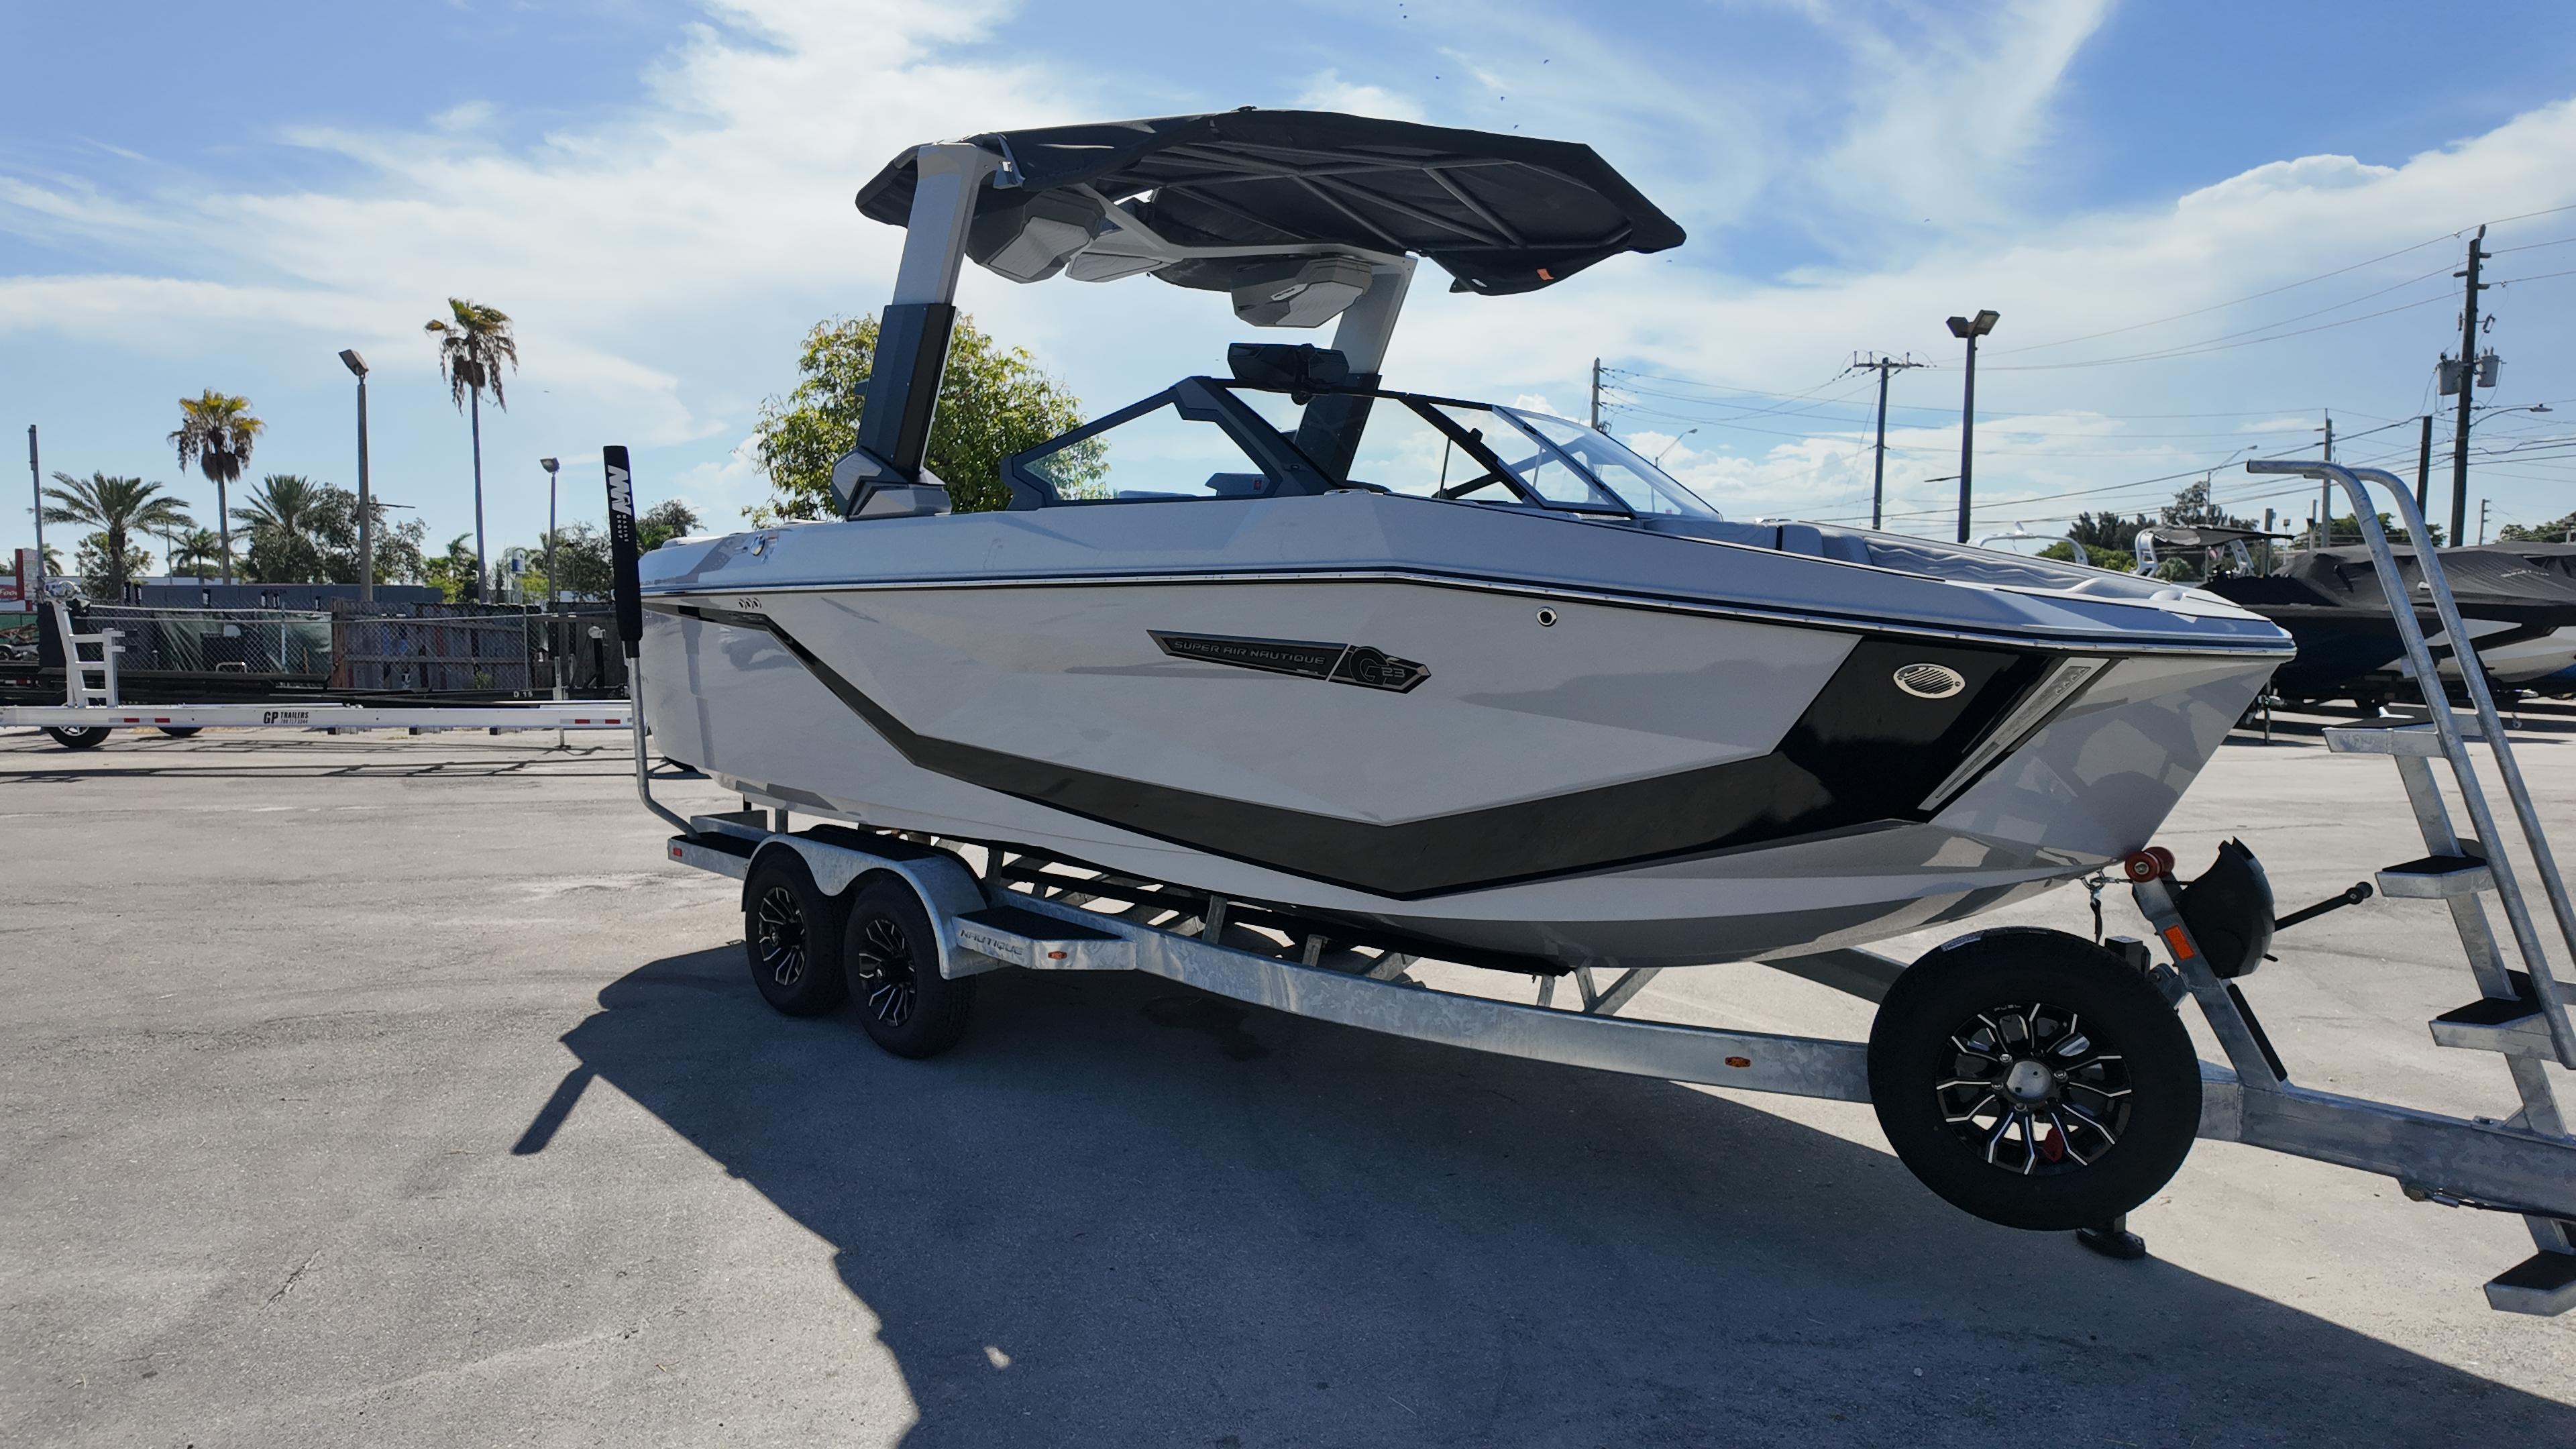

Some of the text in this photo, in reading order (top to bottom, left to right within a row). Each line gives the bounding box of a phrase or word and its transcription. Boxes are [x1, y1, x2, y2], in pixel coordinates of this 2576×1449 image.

[1175, 641, 1326, 664] SUPER AIR NAUTIQUE
[263, 711, 309, 724] GP TRAILERS
[961, 929, 1023, 955] NAUTIQUE
